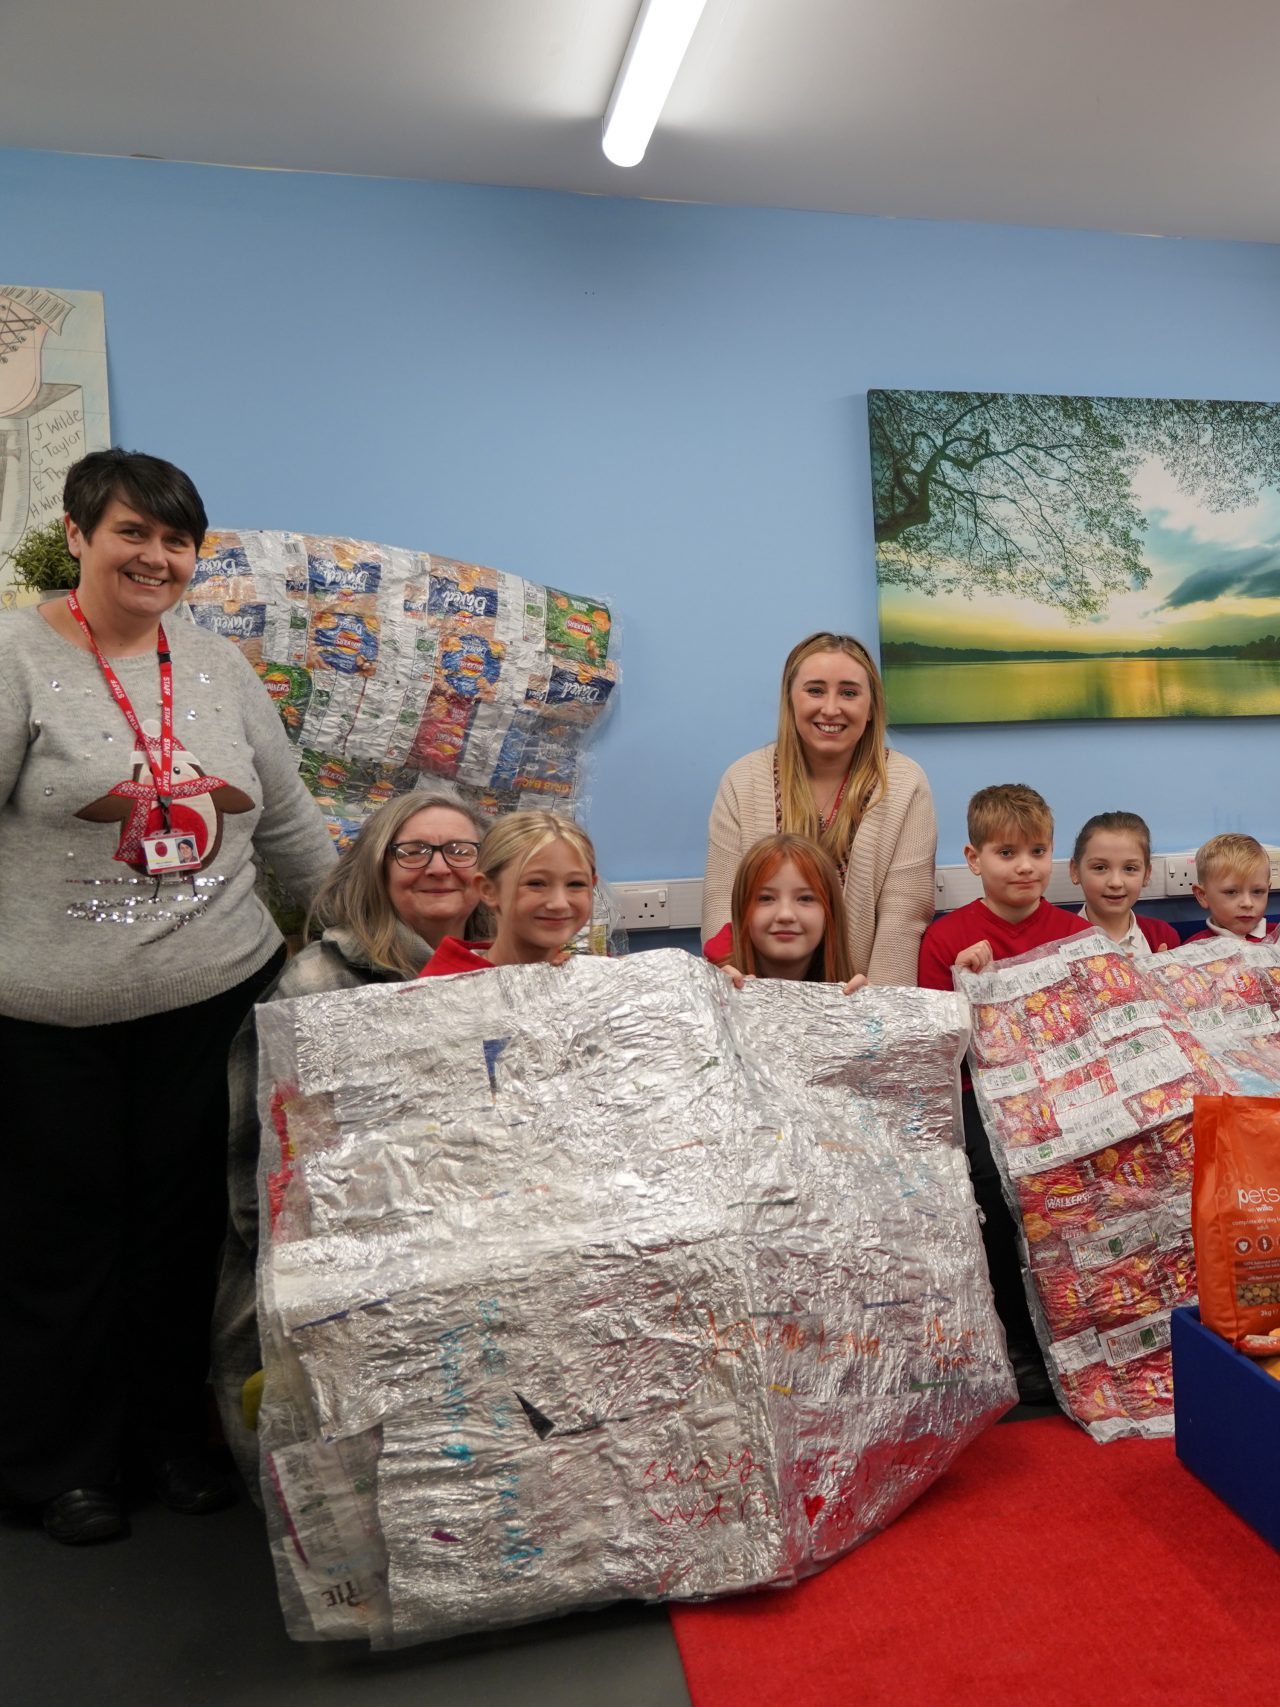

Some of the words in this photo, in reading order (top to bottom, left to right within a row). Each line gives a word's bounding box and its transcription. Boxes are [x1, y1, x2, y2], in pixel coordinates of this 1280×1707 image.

[46, 409, 84, 434] Wilde
[42, 431, 82, 458] Taylor
[110, 679, 125, 699] STAFF
[163, 676, 171, 697] STAFF
[163, 737, 171, 758] STAFF
[1047, 1194, 1089, 1210] WALKERS
[1237, 1186, 1280, 1210] pets
